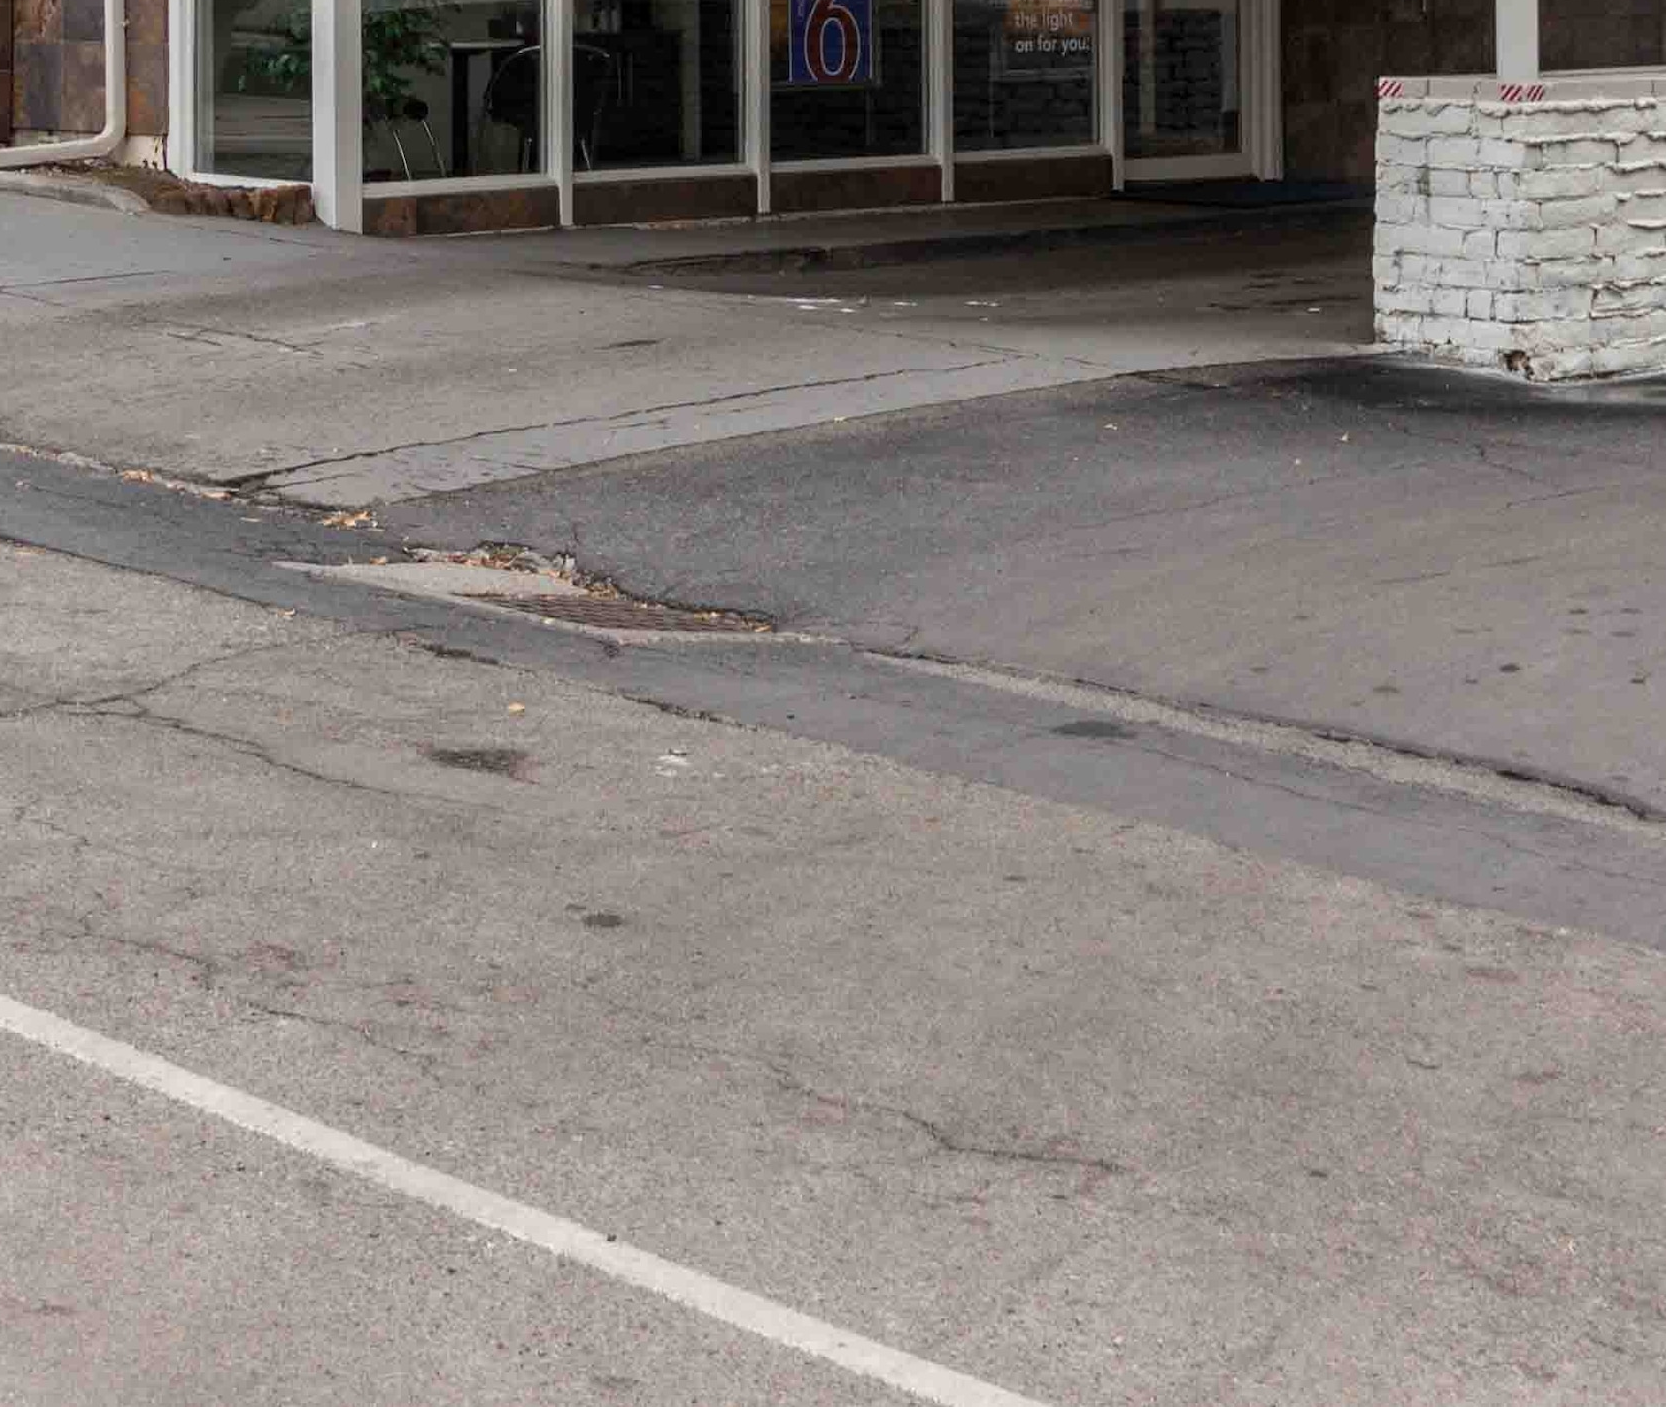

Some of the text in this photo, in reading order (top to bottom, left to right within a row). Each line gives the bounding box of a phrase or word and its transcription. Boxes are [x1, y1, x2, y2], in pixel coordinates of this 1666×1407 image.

[1015, 6, 1073, 31] the light
[1016, 39, 1033, 53] on
[1037, 35, 1057, 51] for
